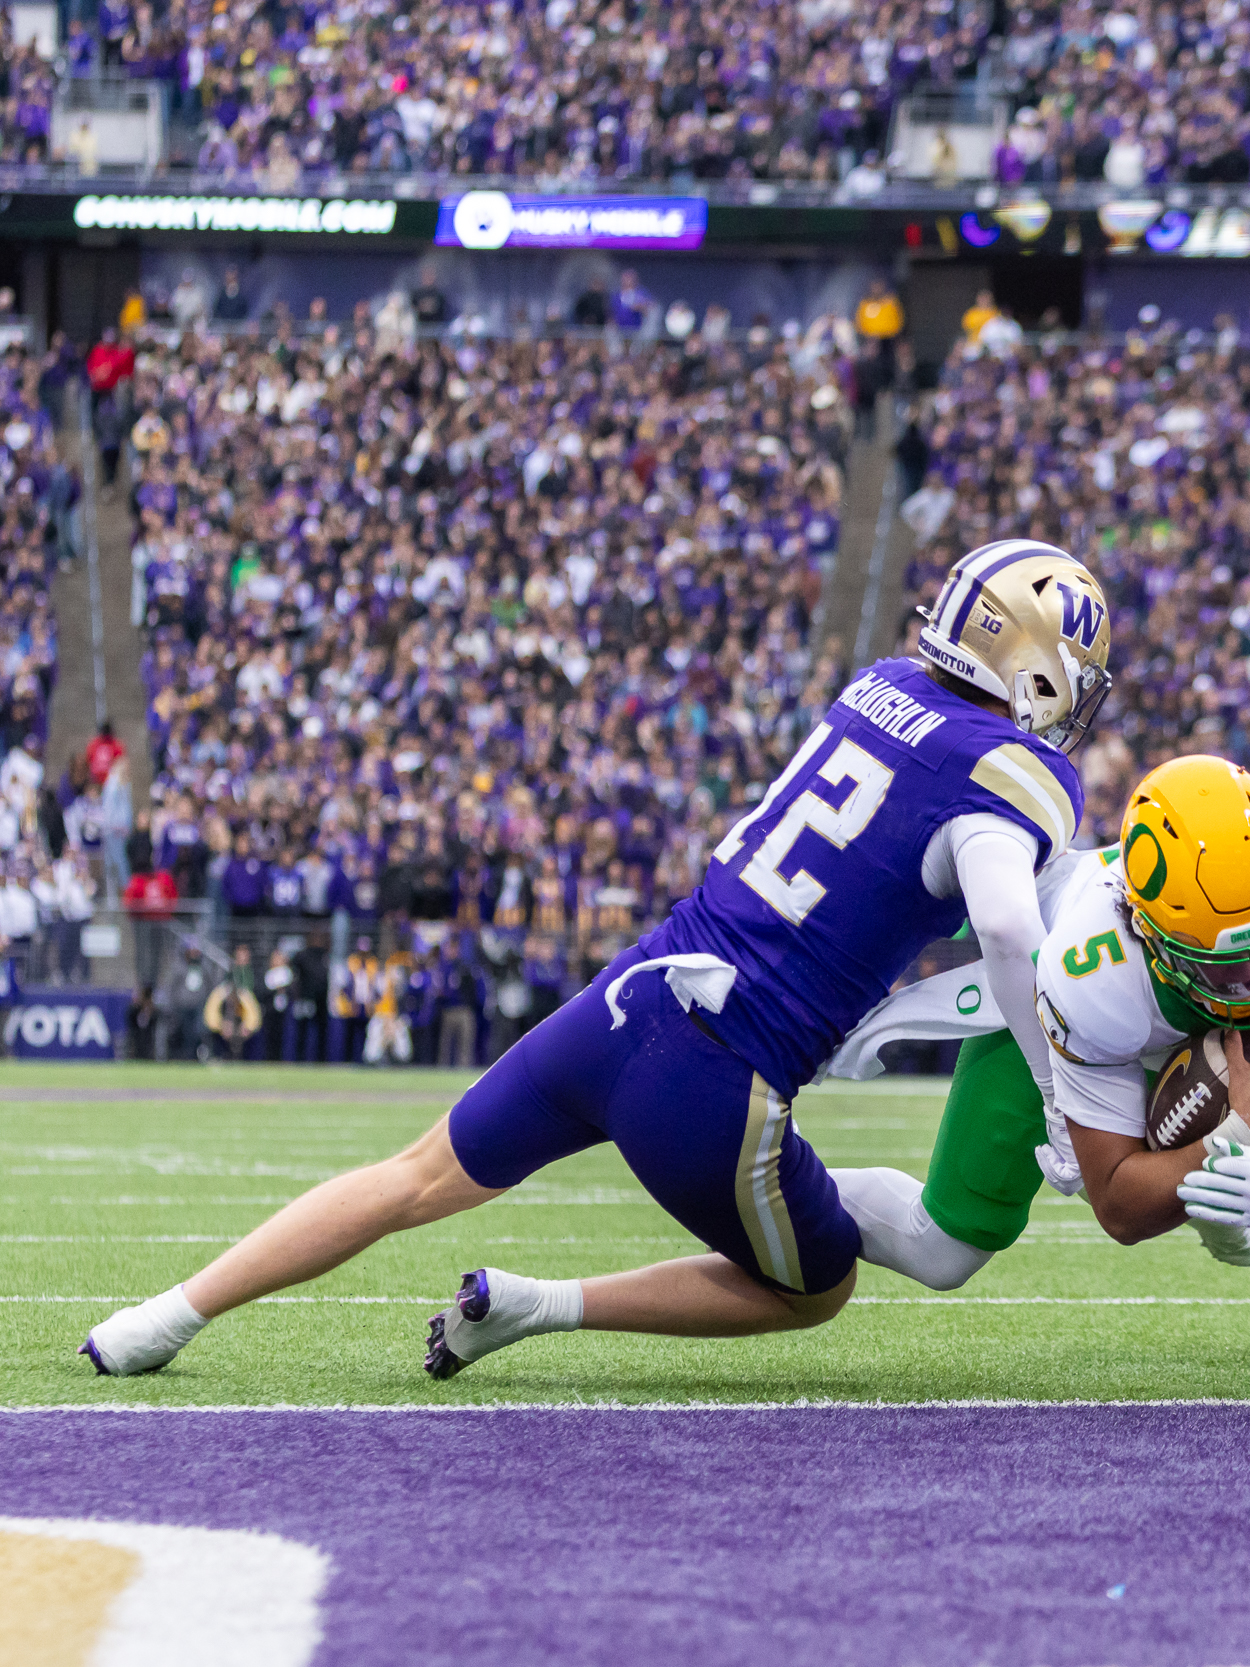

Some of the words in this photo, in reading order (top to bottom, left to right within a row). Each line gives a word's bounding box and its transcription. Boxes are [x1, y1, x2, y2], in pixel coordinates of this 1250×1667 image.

[1056, 580, 1106, 651] W
[711, 720, 895, 926] 12
[1061, 927, 1128, 980] 5
